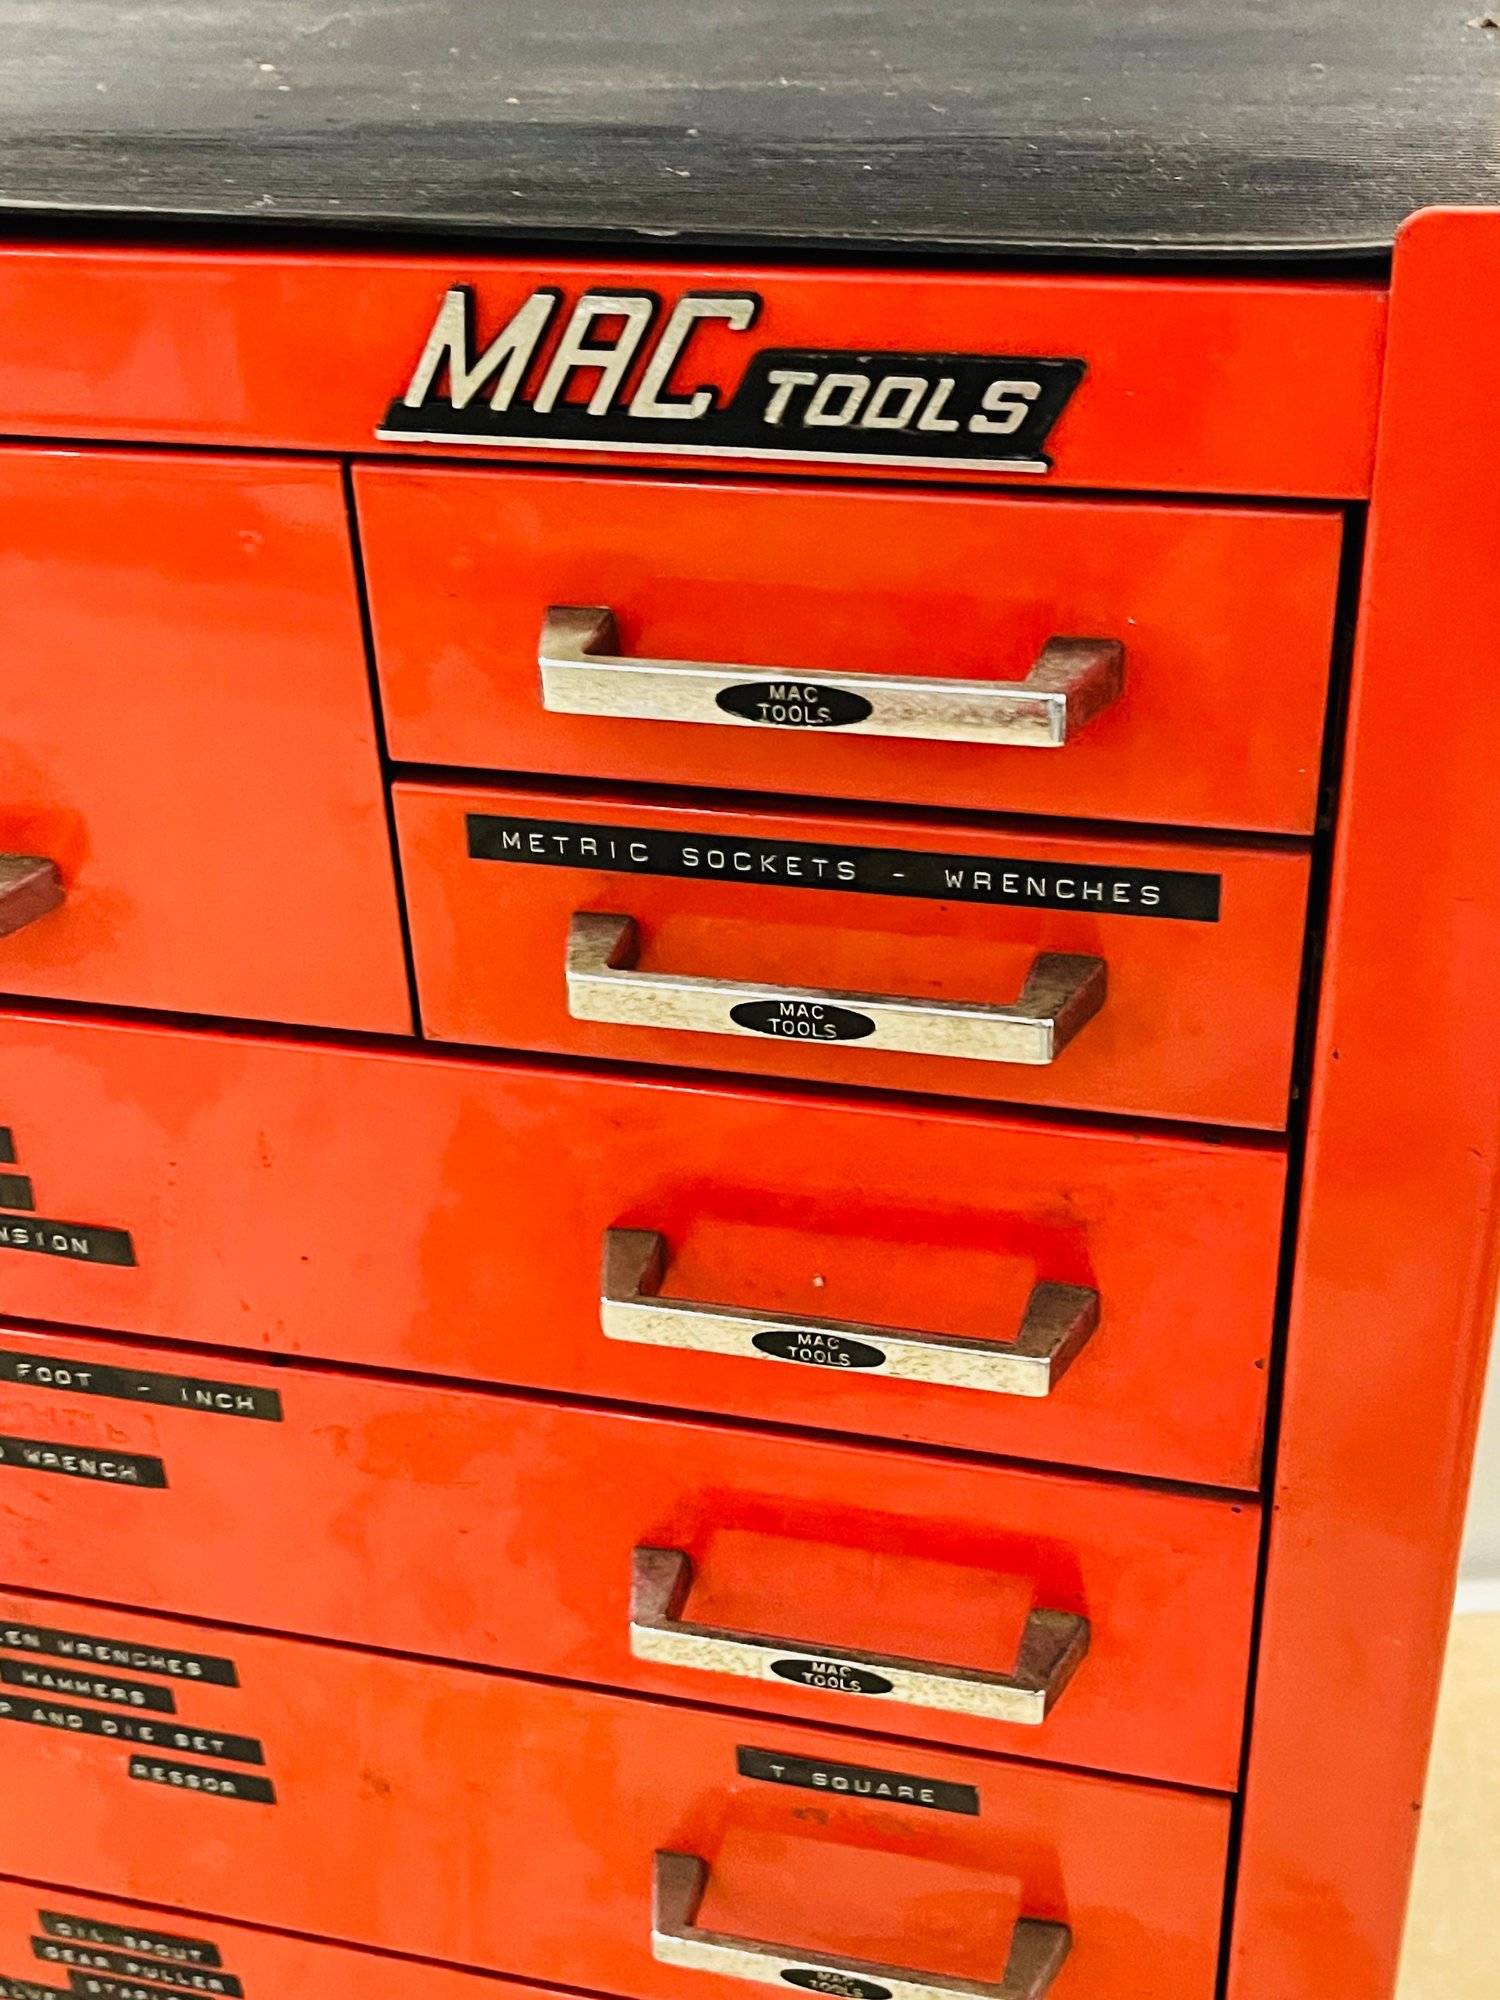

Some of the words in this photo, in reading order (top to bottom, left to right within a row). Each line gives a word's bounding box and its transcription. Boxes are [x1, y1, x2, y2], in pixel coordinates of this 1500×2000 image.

[404, 290, 756, 420] MAC
[764, 370, 1043, 436] TOOLS
[768, 684, 819, 702] MAC
[757, 703, 832, 723] TOOLS
[502, 830, 651, 863] METRIC
[682, 847, 858, 882] SOCKETS
[945, 869, 1163, 906] WRENCHES
[779, 1002, 825, 1020] MAC
[767, 1018, 838, 1039] TOOLS
[787, 1345, 852, 1366] TOOLS
[797, 1333, 840, 1350] MAC
[16, 1363, 92, 1387] FOOT
[180, 1387, 255, 1411] INCH
[23, 1449, 138, 1479] WRENCH
[0, 1630, 41, 1647] EN
[57, 1638, 203, 1676] WRENCHES
[801, 1673, 862, 1691] TOOLS
[812, 1661, 852, 1677] MAC
[22, 1669, 146, 1705] HAMMERS
[32, 1707, 84, 1729] AND
[101, 1719, 154, 1741] DIE
[175, 1733, 225, 1753] SET
[132, 1763, 237, 1794] RESSOR
[770, 1764, 786, 1780] T
[812, 1772, 936, 1804] SQUARE
[126, 1962, 225, 1993] PULLER
